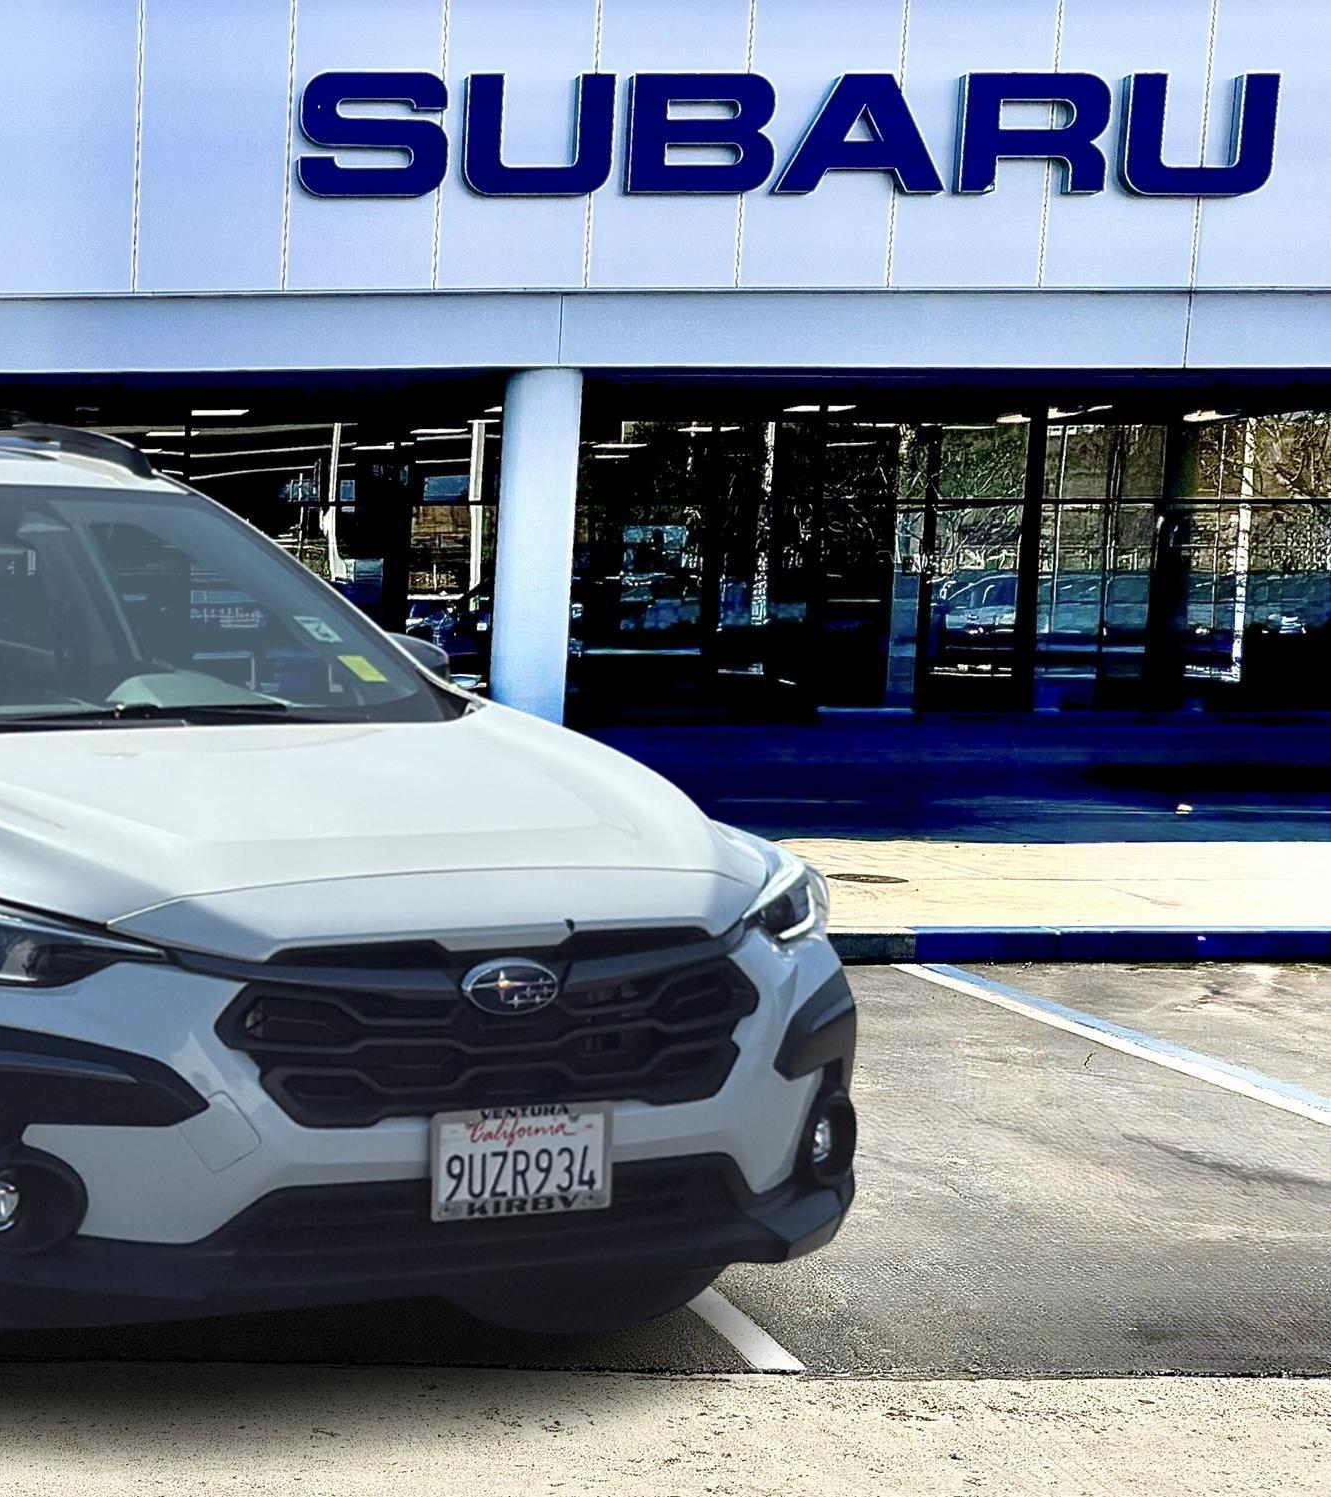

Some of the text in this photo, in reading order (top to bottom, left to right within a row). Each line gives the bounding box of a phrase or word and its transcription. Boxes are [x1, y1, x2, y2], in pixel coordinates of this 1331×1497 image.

[296, 72, 1279, 200] SUBARU
[481, 1104, 569, 1121] VENTURA
[470, 1118, 578, 1148] California
[445, 1145, 597, 1202] 9UZR934
[467, 1194, 579, 1217] KIRBY
